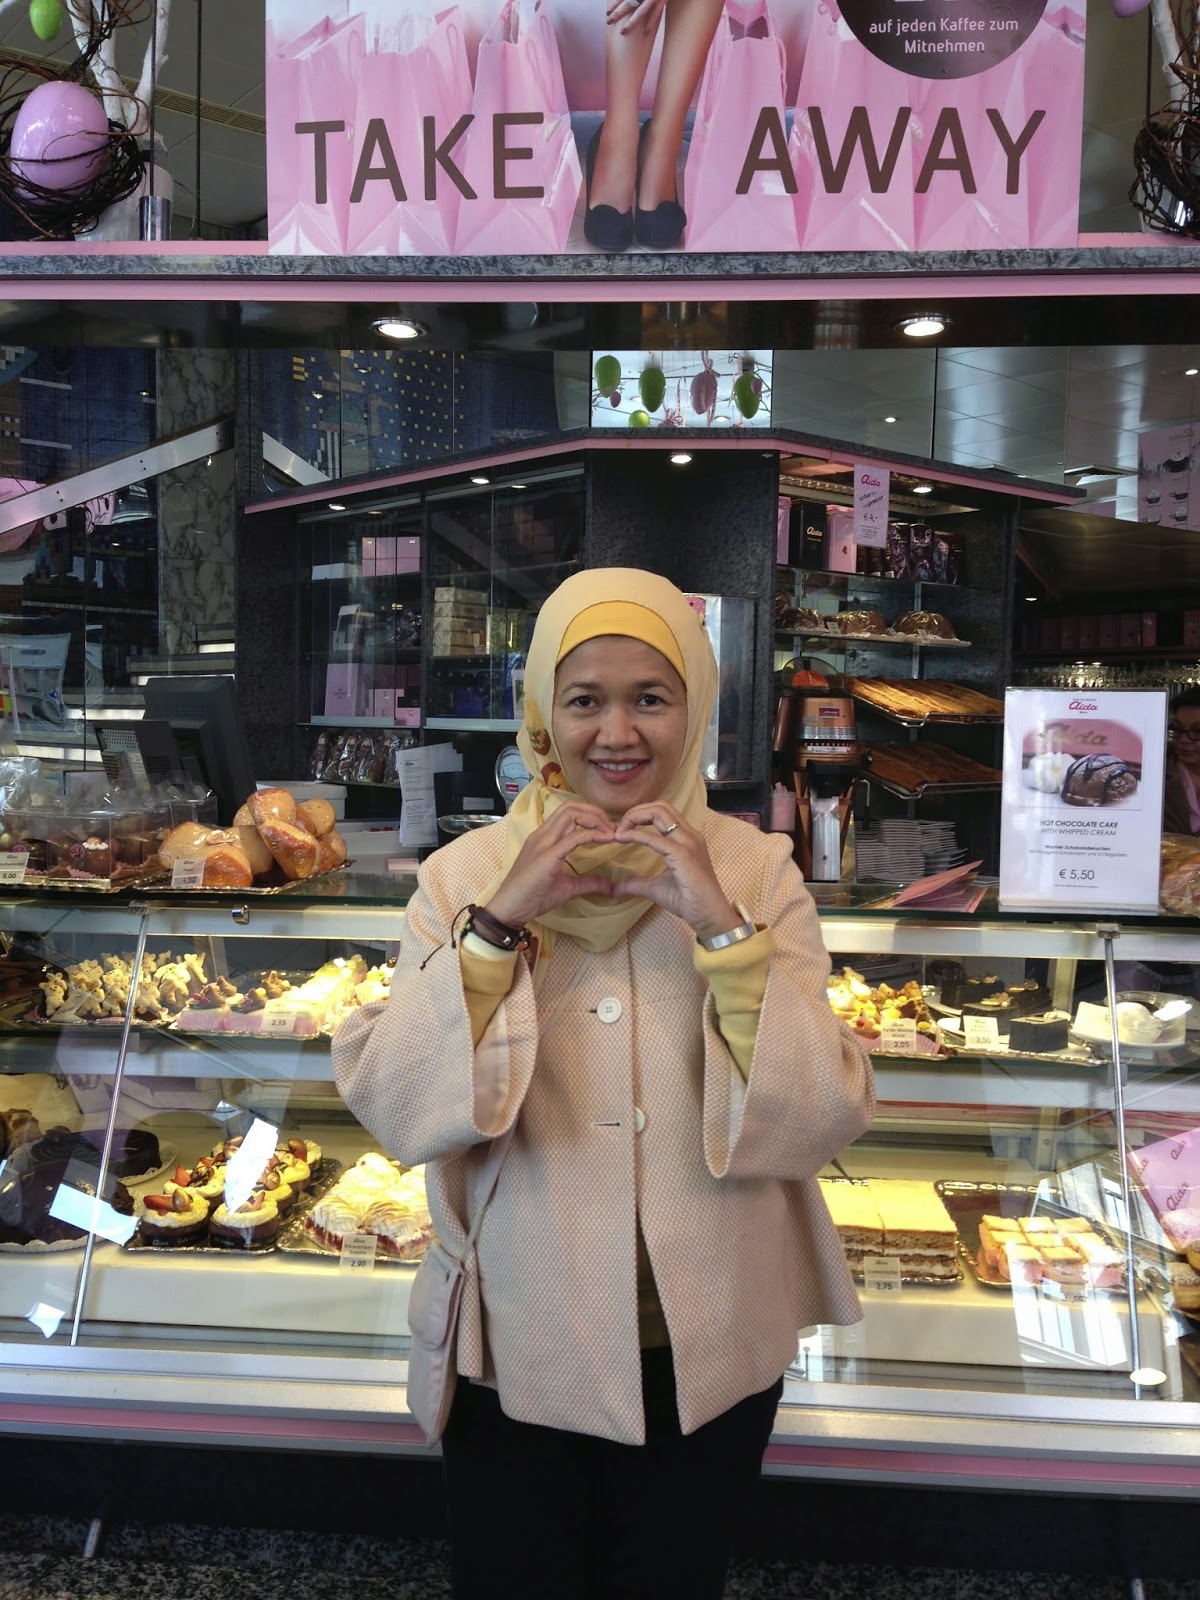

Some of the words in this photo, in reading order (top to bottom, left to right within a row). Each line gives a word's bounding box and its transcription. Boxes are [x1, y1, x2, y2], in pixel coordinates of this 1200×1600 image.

[869, 19, 893, 33] auf
[896, 18, 936, 36] jeden
[940, 17, 985, 31] Kaffee
[989, 20, 1019, 31] zum
[904, 39, 985, 53] Mitnehmen
[295, 112, 544, 205] TAKE
[735, 106, 1047, 195] AWAY
[1069, 701, 1099, 711] Aida
[1055, 820, 1098, 828] CHOCOLATE
[1099, 821, 1119, 829] CAKE
[1058, 868, 1067, 879] €
[1165, 1181, 1190, 1212] Aida
